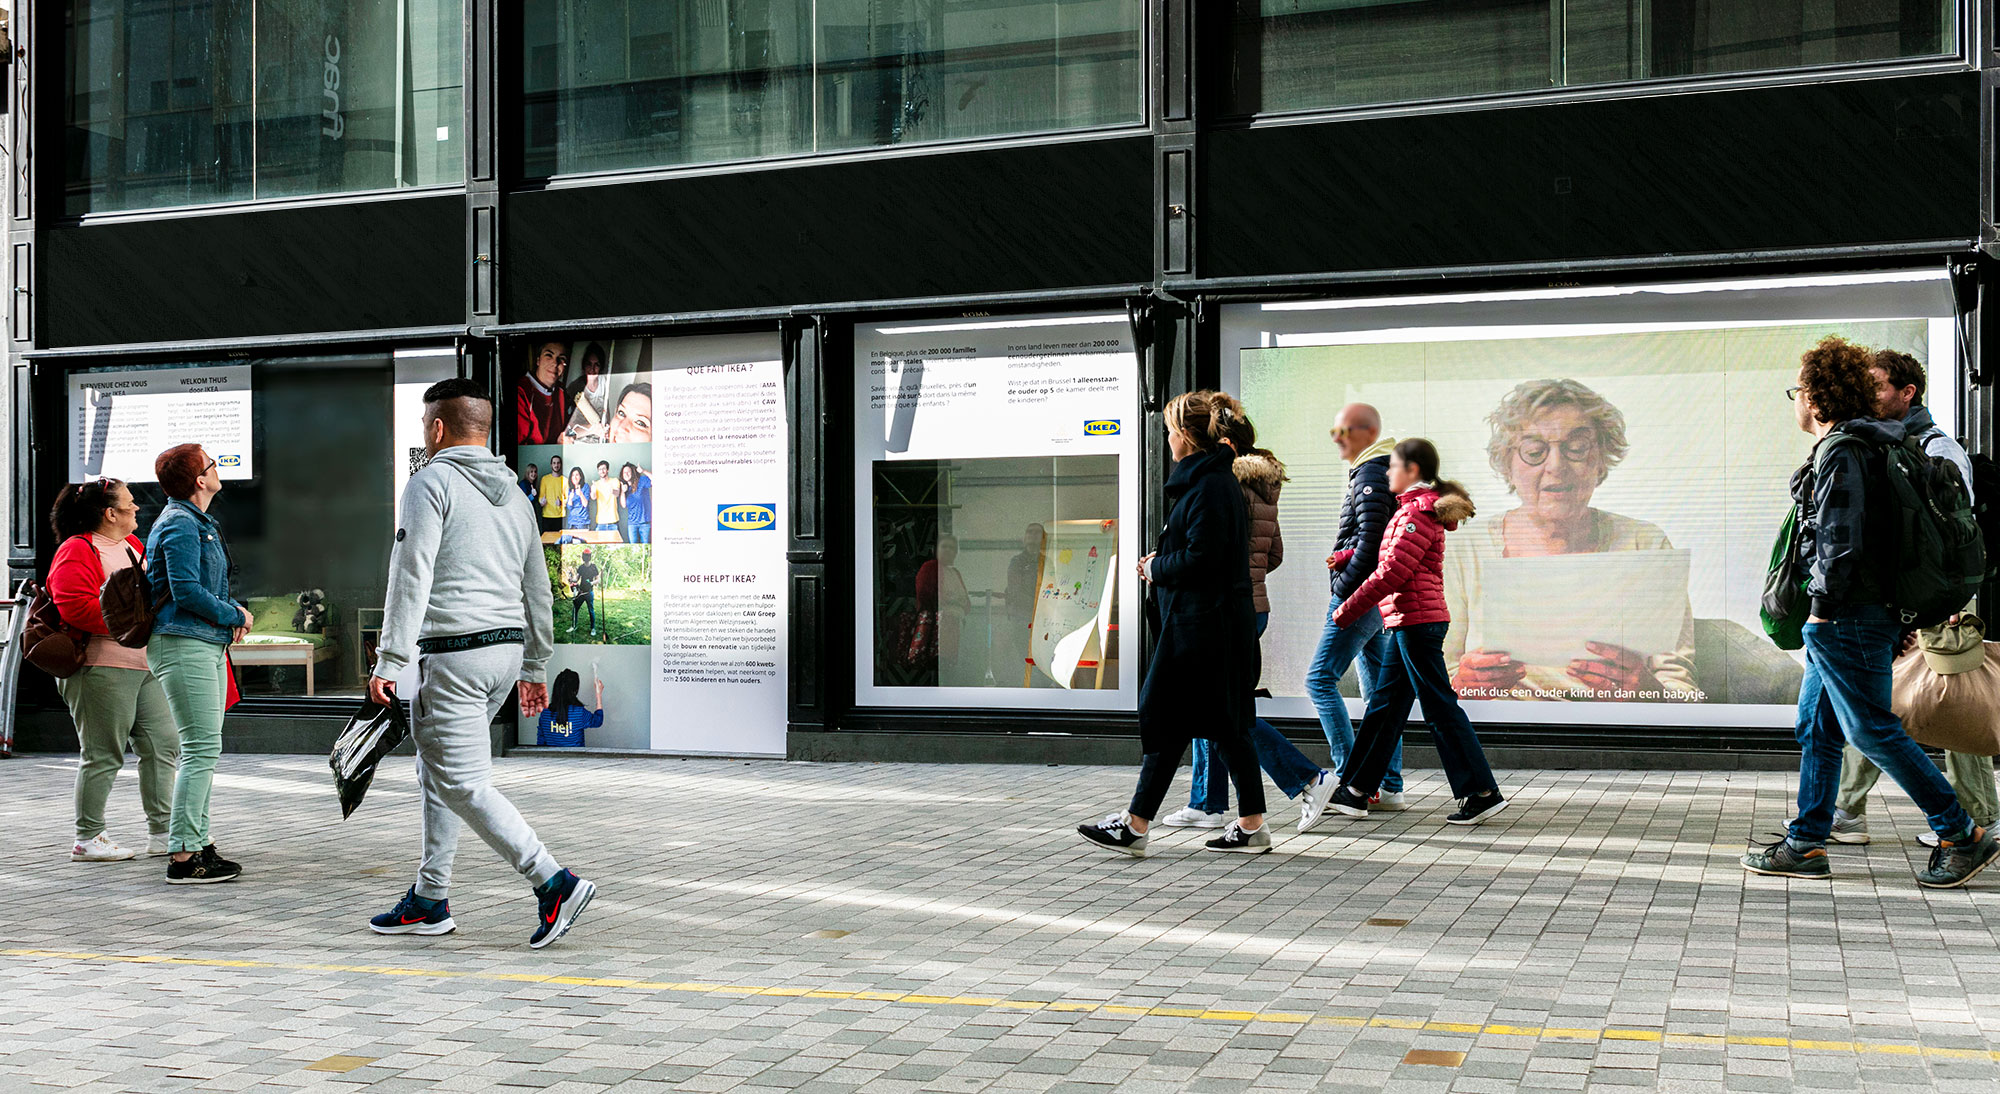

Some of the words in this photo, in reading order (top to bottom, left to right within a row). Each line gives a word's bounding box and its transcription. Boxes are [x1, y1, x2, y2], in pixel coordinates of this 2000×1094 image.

[687, 366, 704, 375] QUE
[723, 512, 770, 522] IKEA
[1460, 686, 1486, 696] denk
[1489, 687, 1508, 697] dus
[1534, 687, 1567, 697] ouder
[1570, 688, 1594, 698] kind
[1614, 688, 1635, 698] dan
[1663, 689, 1708, 701] babytje.
[550, 721, 572, 737] Hej!
